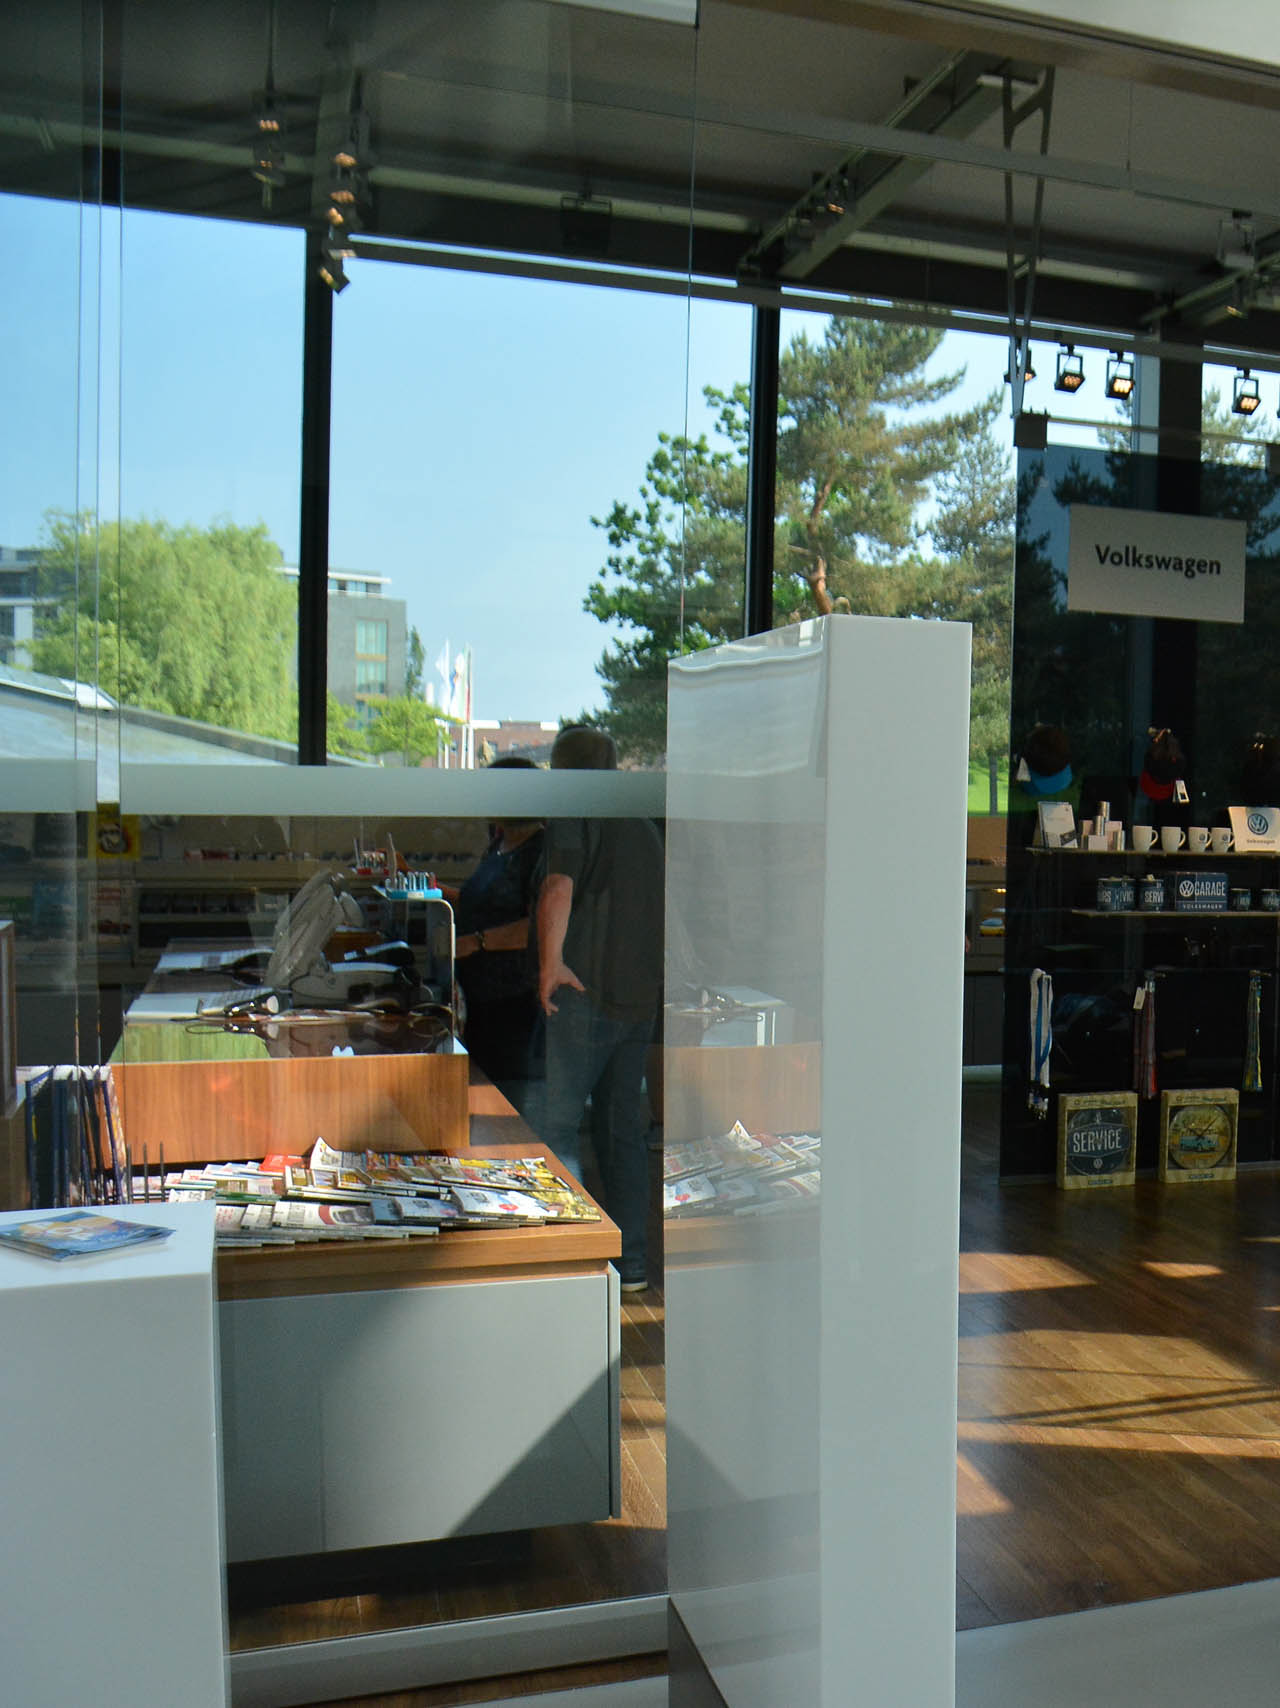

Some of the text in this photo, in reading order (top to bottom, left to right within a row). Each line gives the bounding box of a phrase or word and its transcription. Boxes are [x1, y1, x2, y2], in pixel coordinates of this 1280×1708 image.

[1095, 544, 1221, 579] Volkswagen
[1195, 881, 1226, 896] GARAGE
[1073, 1128, 1122, 1153] SERVICE
